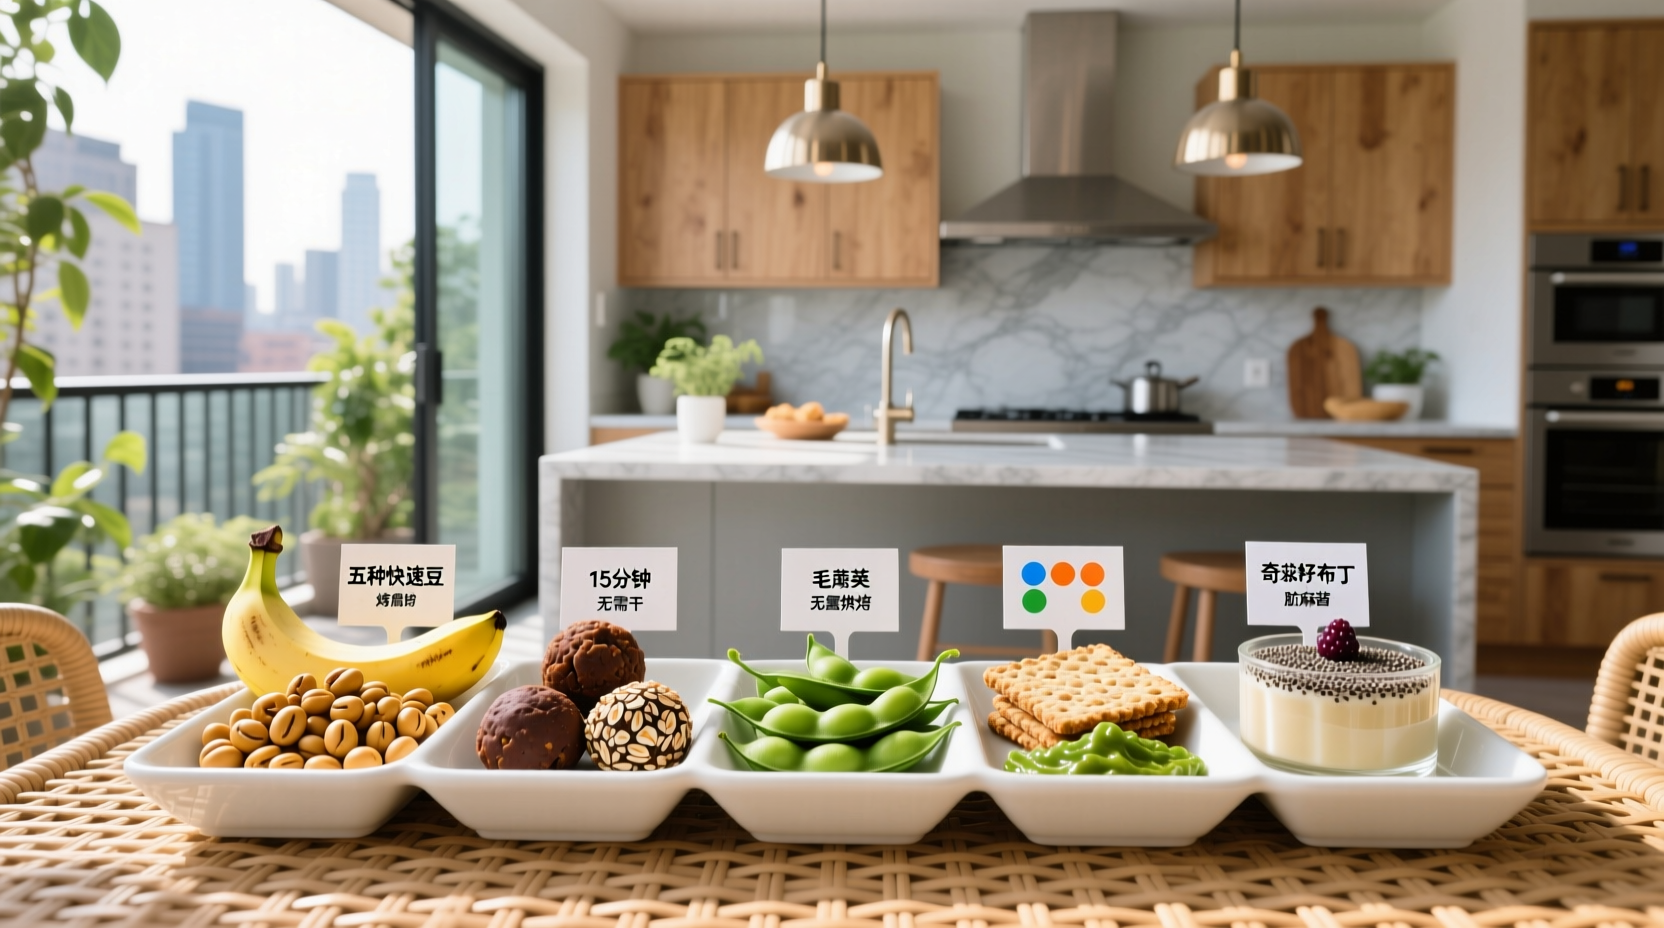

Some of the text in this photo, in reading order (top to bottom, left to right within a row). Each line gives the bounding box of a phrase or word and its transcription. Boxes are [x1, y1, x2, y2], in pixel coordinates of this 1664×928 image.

[348, 565, 444, 587] 五种快速豆
[590, 567, 652, 590] 15分钟
